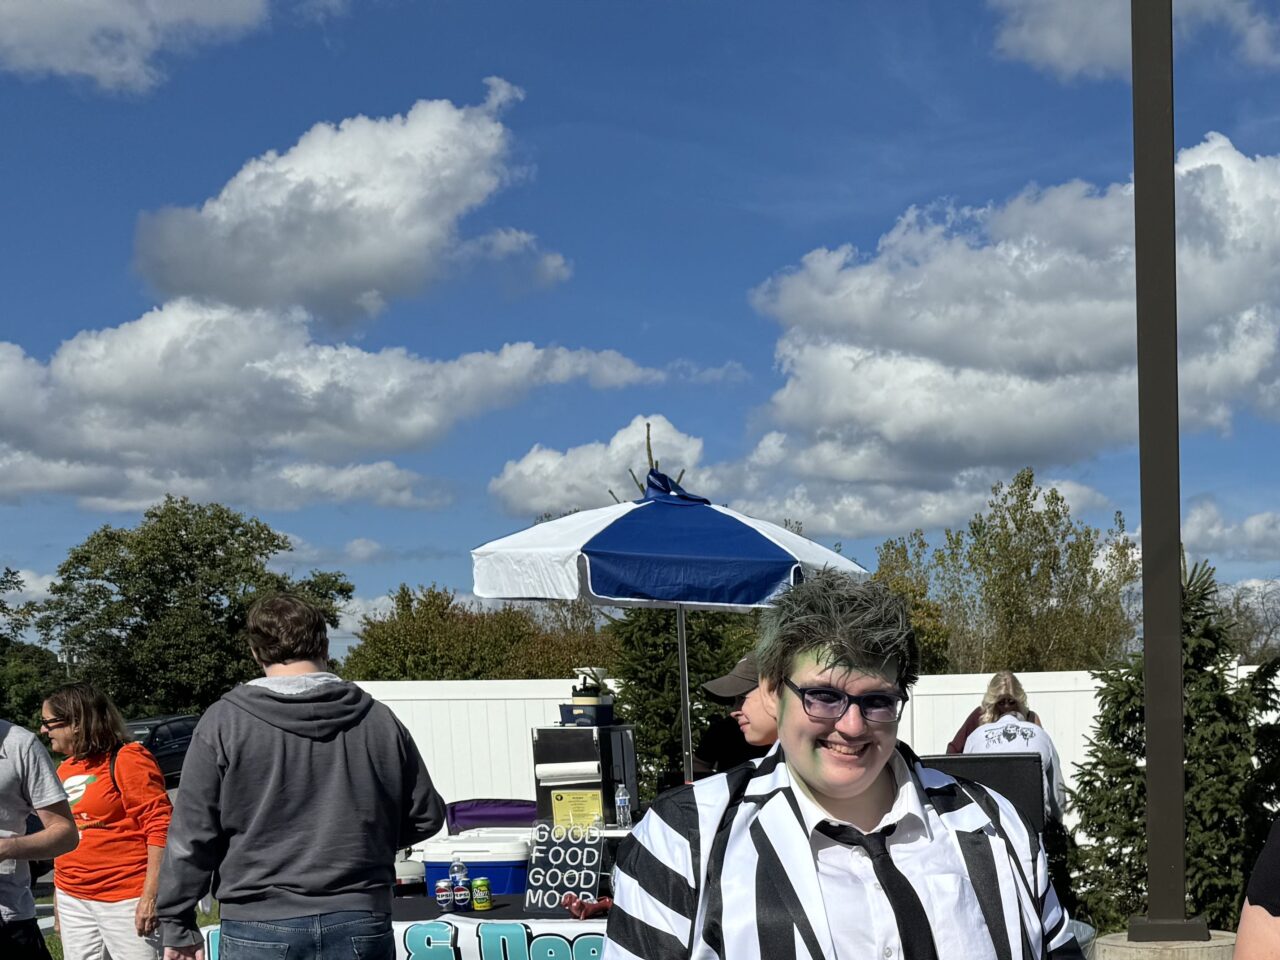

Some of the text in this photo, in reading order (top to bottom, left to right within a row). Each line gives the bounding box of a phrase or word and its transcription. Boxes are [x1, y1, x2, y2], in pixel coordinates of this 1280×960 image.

[535, 823, 601, 845] GOOD
[531, 846, 600, 867] FOOD
[528, 867, 597, 889] GOOD
